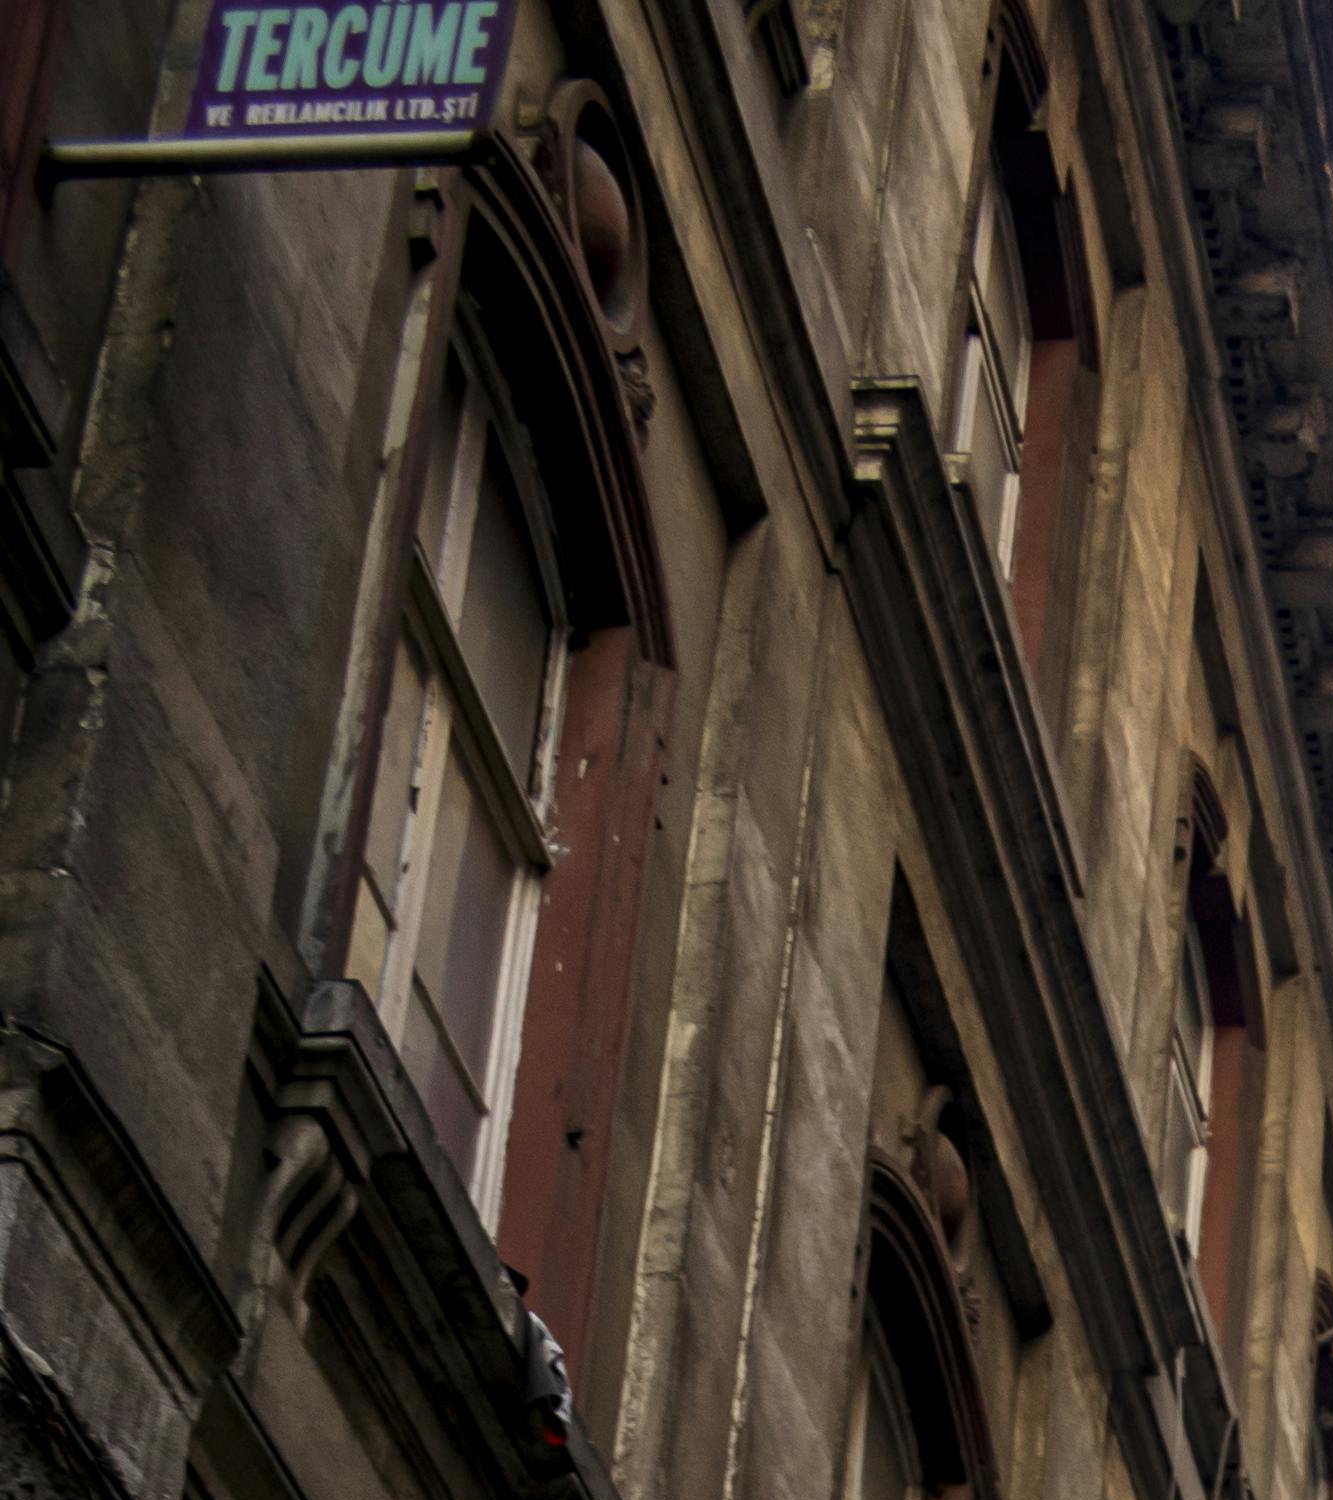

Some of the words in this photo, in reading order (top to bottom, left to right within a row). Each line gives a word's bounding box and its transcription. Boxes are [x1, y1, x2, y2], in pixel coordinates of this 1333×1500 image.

[216, 0, 500, 92] TERCÜME
[205, 105, 234, 128] VE
[244, 97, 389, 127] REKLAMCILIK
